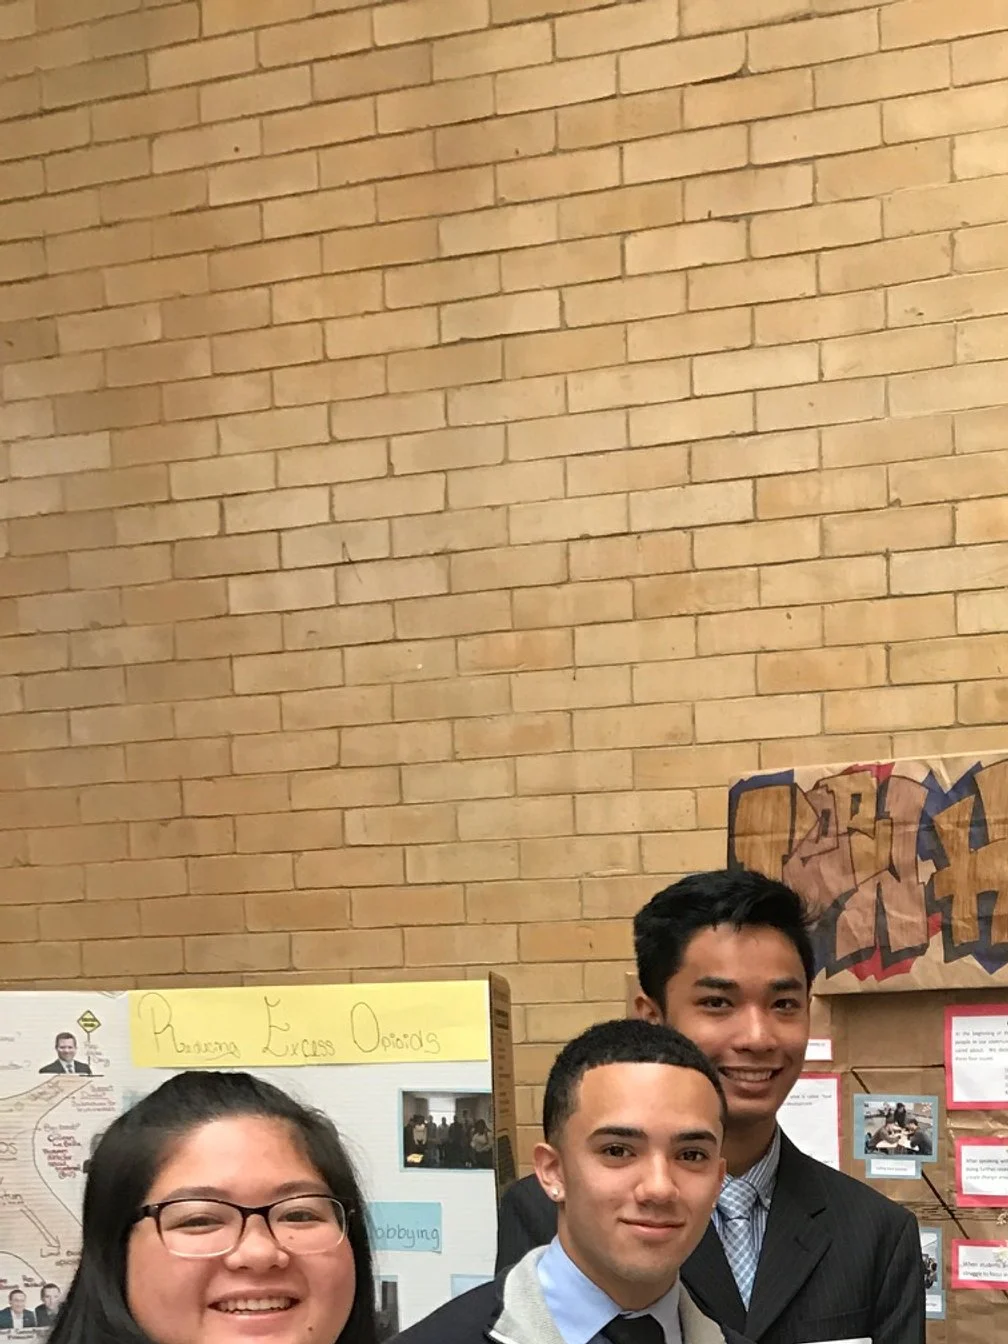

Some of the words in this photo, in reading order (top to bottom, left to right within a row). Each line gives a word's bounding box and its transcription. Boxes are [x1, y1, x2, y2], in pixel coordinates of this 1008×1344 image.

[263, 996, 335, 1057] Excess
[350, 1001, 441, 1054] Opioids
[375, 1224, 440, 1249] obbying
